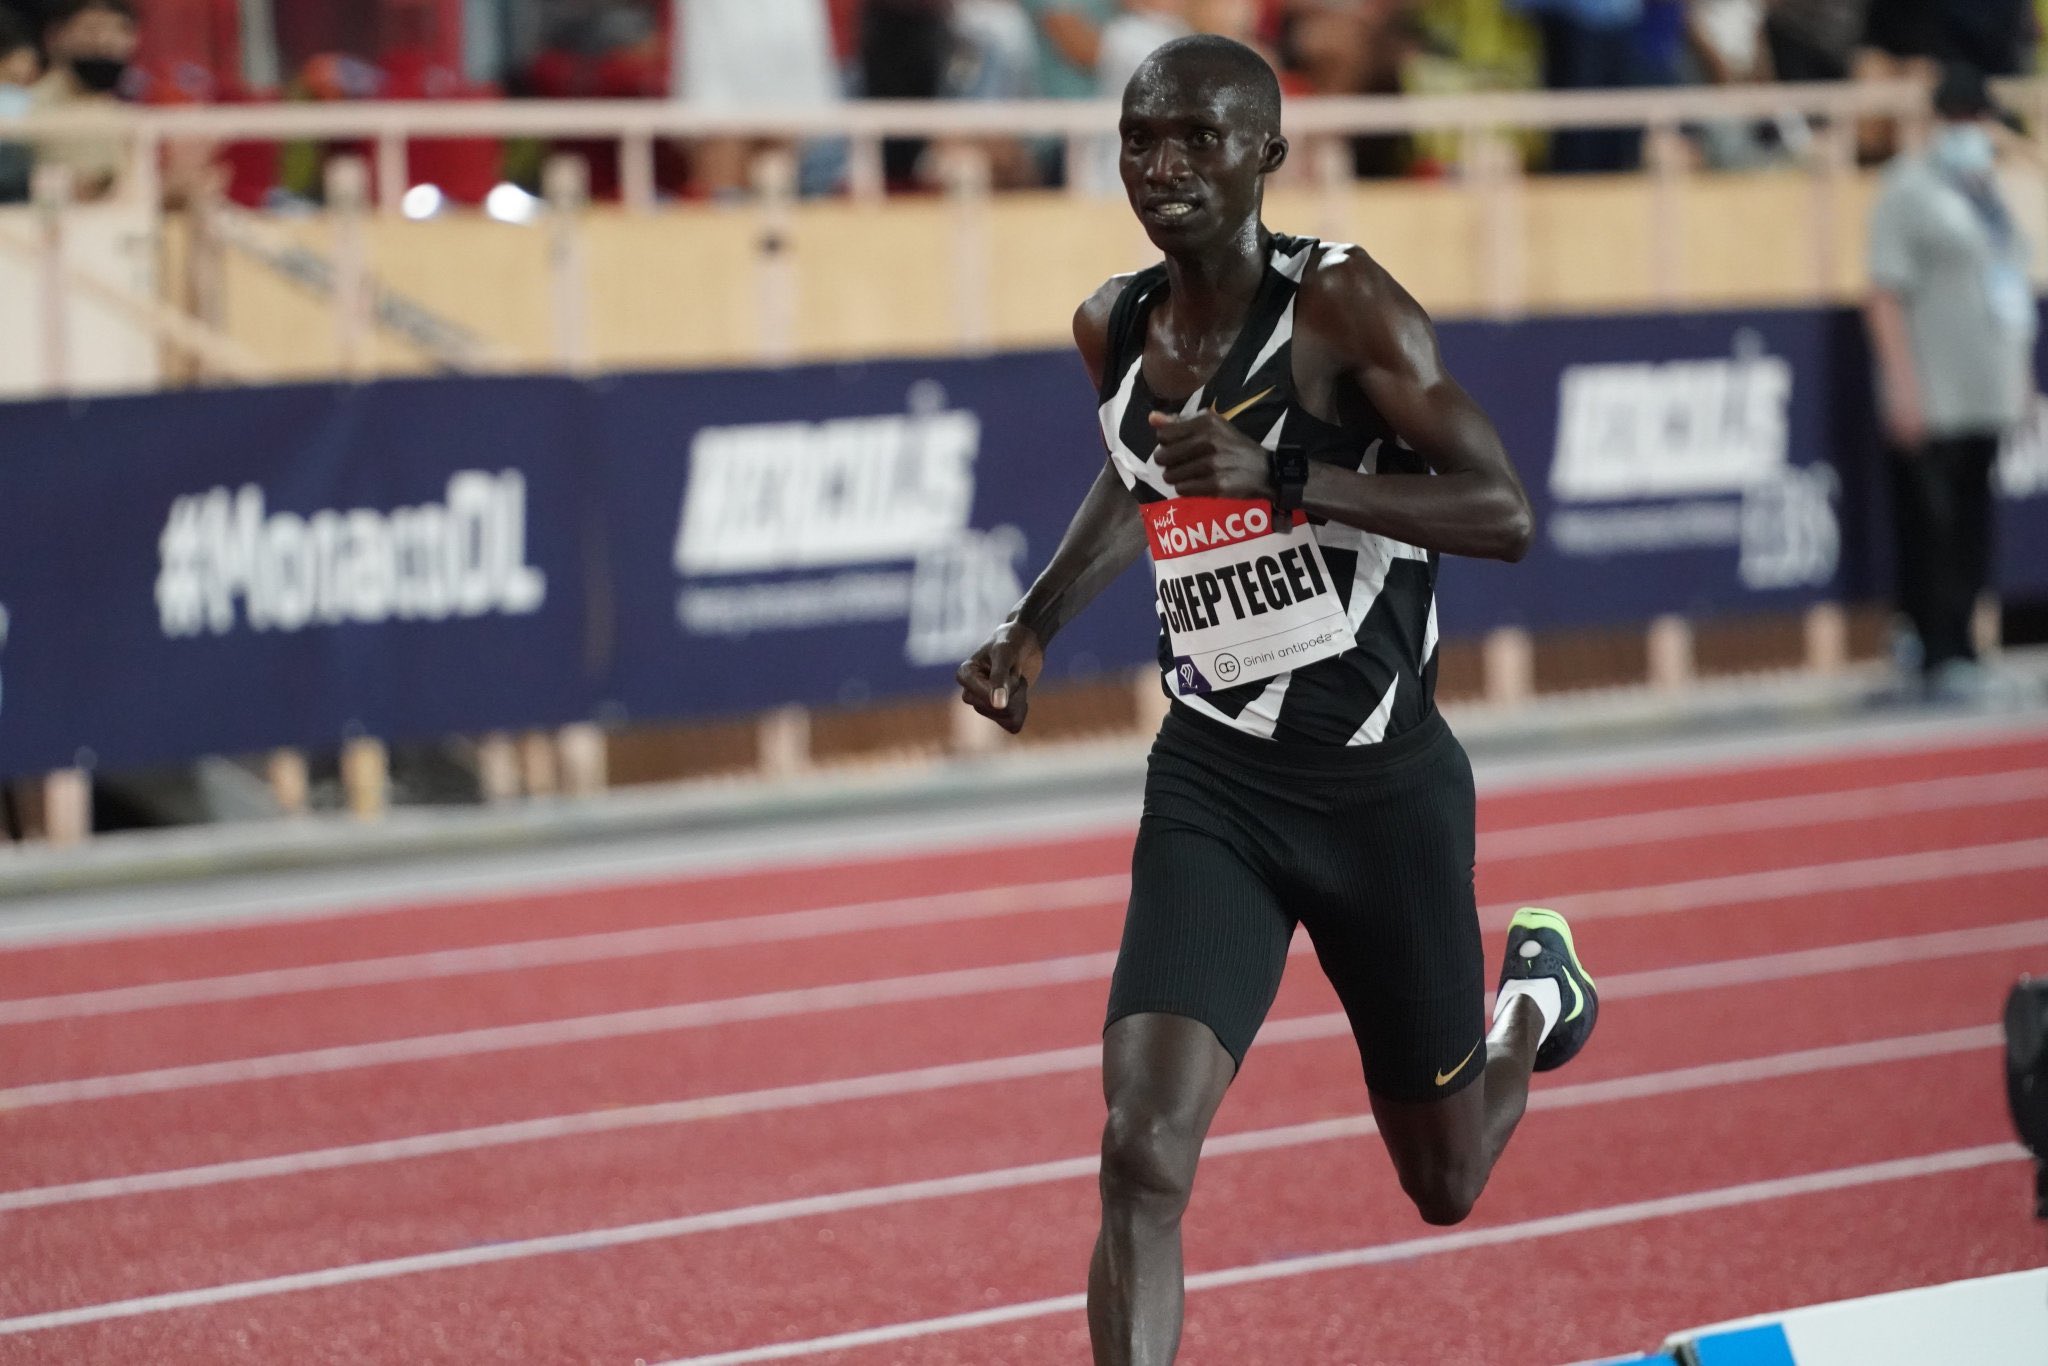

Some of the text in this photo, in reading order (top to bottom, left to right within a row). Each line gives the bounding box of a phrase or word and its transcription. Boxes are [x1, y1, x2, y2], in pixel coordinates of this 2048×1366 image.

[1153, 505, 1178, 530] visit
[1157, 508, 1268, 554] MONACO
[1159, 542, 1327, 634] CHEPTEGEI
[1243, 633, 1332, 667] Ginini antipode
